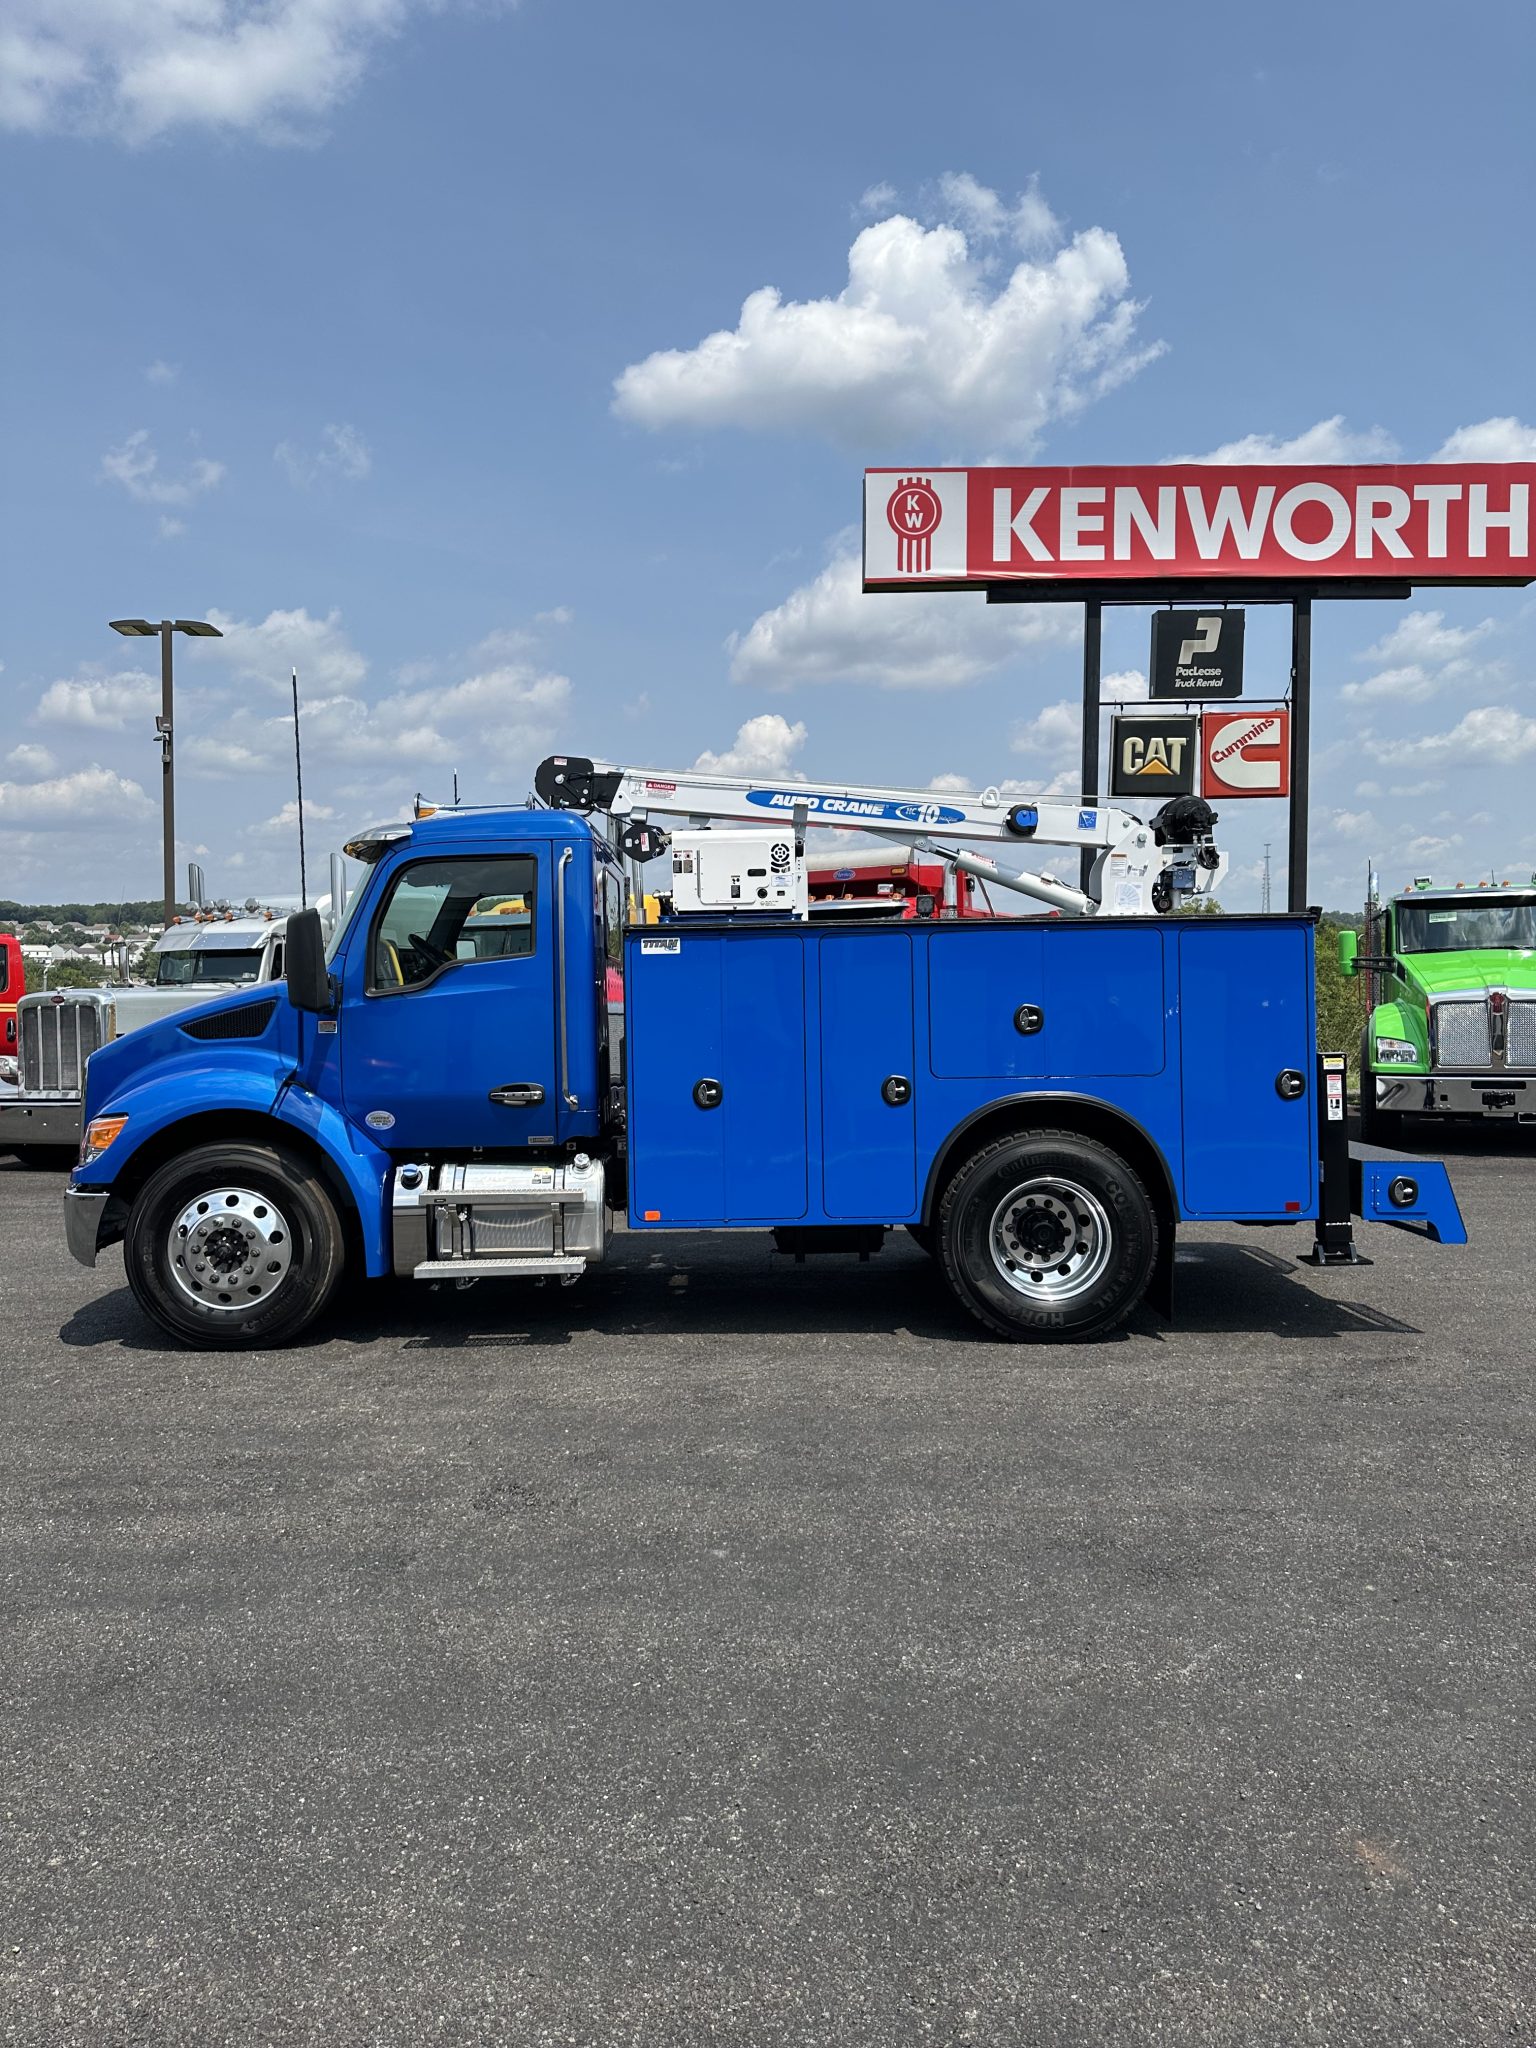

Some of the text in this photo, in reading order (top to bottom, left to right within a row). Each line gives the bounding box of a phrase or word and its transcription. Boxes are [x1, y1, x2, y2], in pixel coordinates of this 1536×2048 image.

[907, 494, 920, 511] K
[904, 512, 924, 529] W
[992, 482, 1530, 562] KENWORTH
[1175, 666, 1222, 676] PacLease
[1174, 677, 1224, 688] Truck Rental
[1211, 718, 1275, 763] Cummins
[1122, 736, 1188, 775] CAT
[653, 782, 676, 790] DANGER
[822, 798, 885, 815] CRANE
[917, 804, 940, 823] 10
